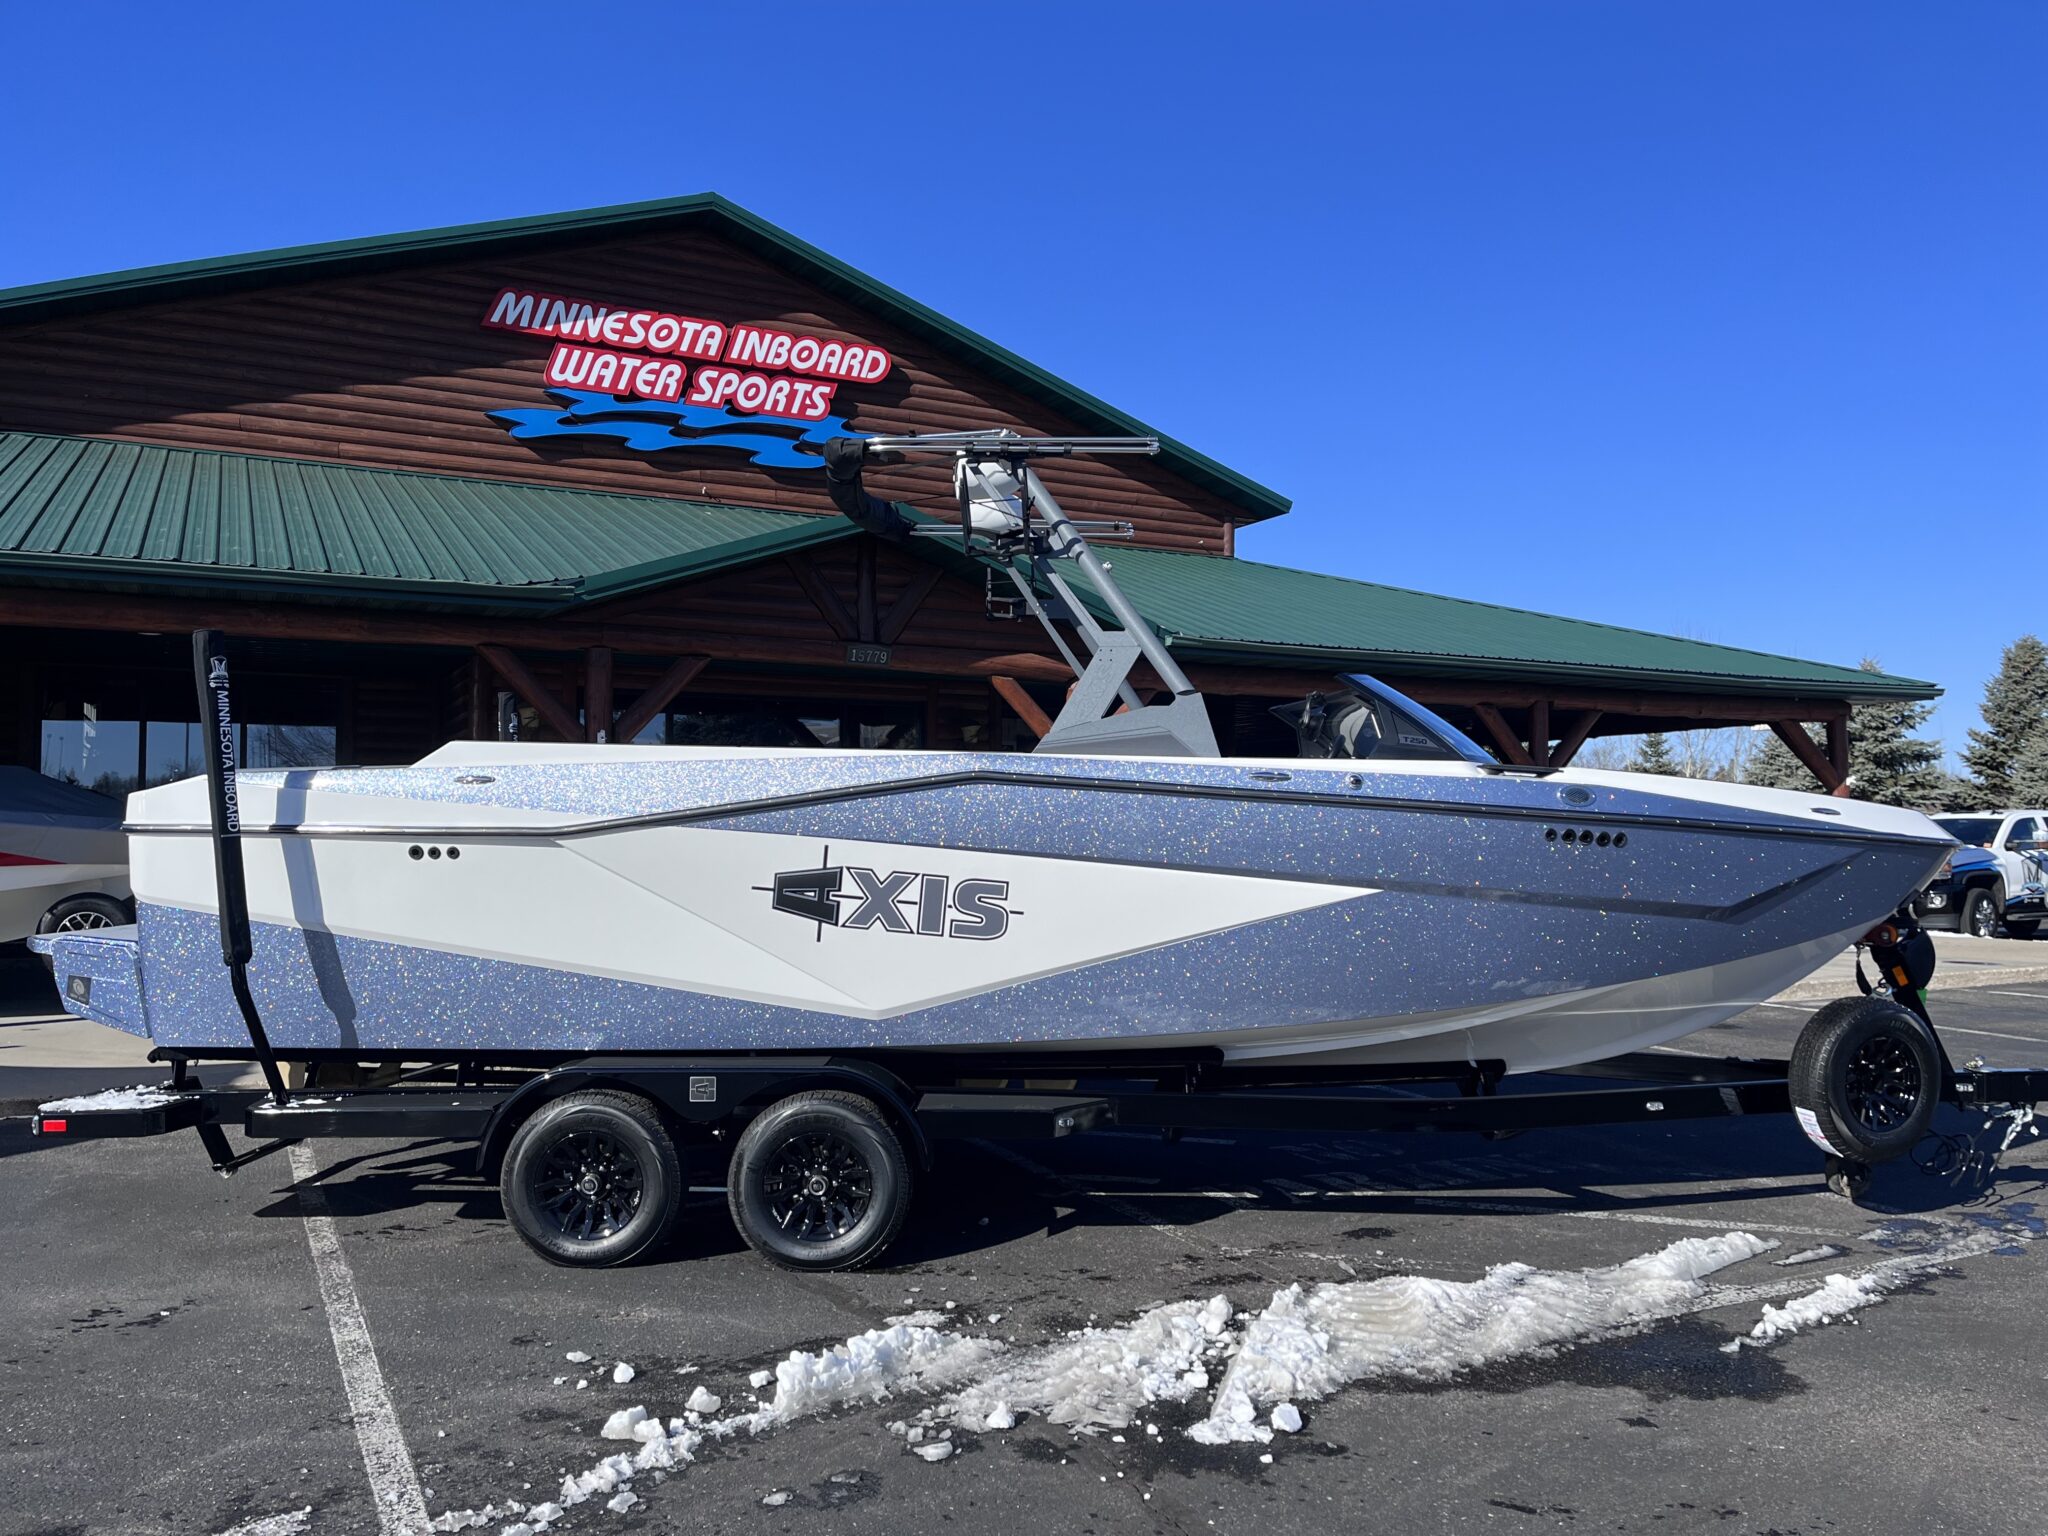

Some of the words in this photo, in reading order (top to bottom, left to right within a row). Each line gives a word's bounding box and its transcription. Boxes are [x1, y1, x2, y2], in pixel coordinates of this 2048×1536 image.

[490, 291, 723, 358] MINNESOTA
[729, 328, 888, 380] INBOARD
[550, 346, 683, 397] WATER
[691, 369, 832, 417] SPORTS
[851, 649, 887, 664] 15779
[216, 690, 234, 769] MINNESOTA
[1402, 736, 1428, 745] T250
[223, 771, 240, 833] INBOARD
[771, 865, 1010, 941] AXIS
